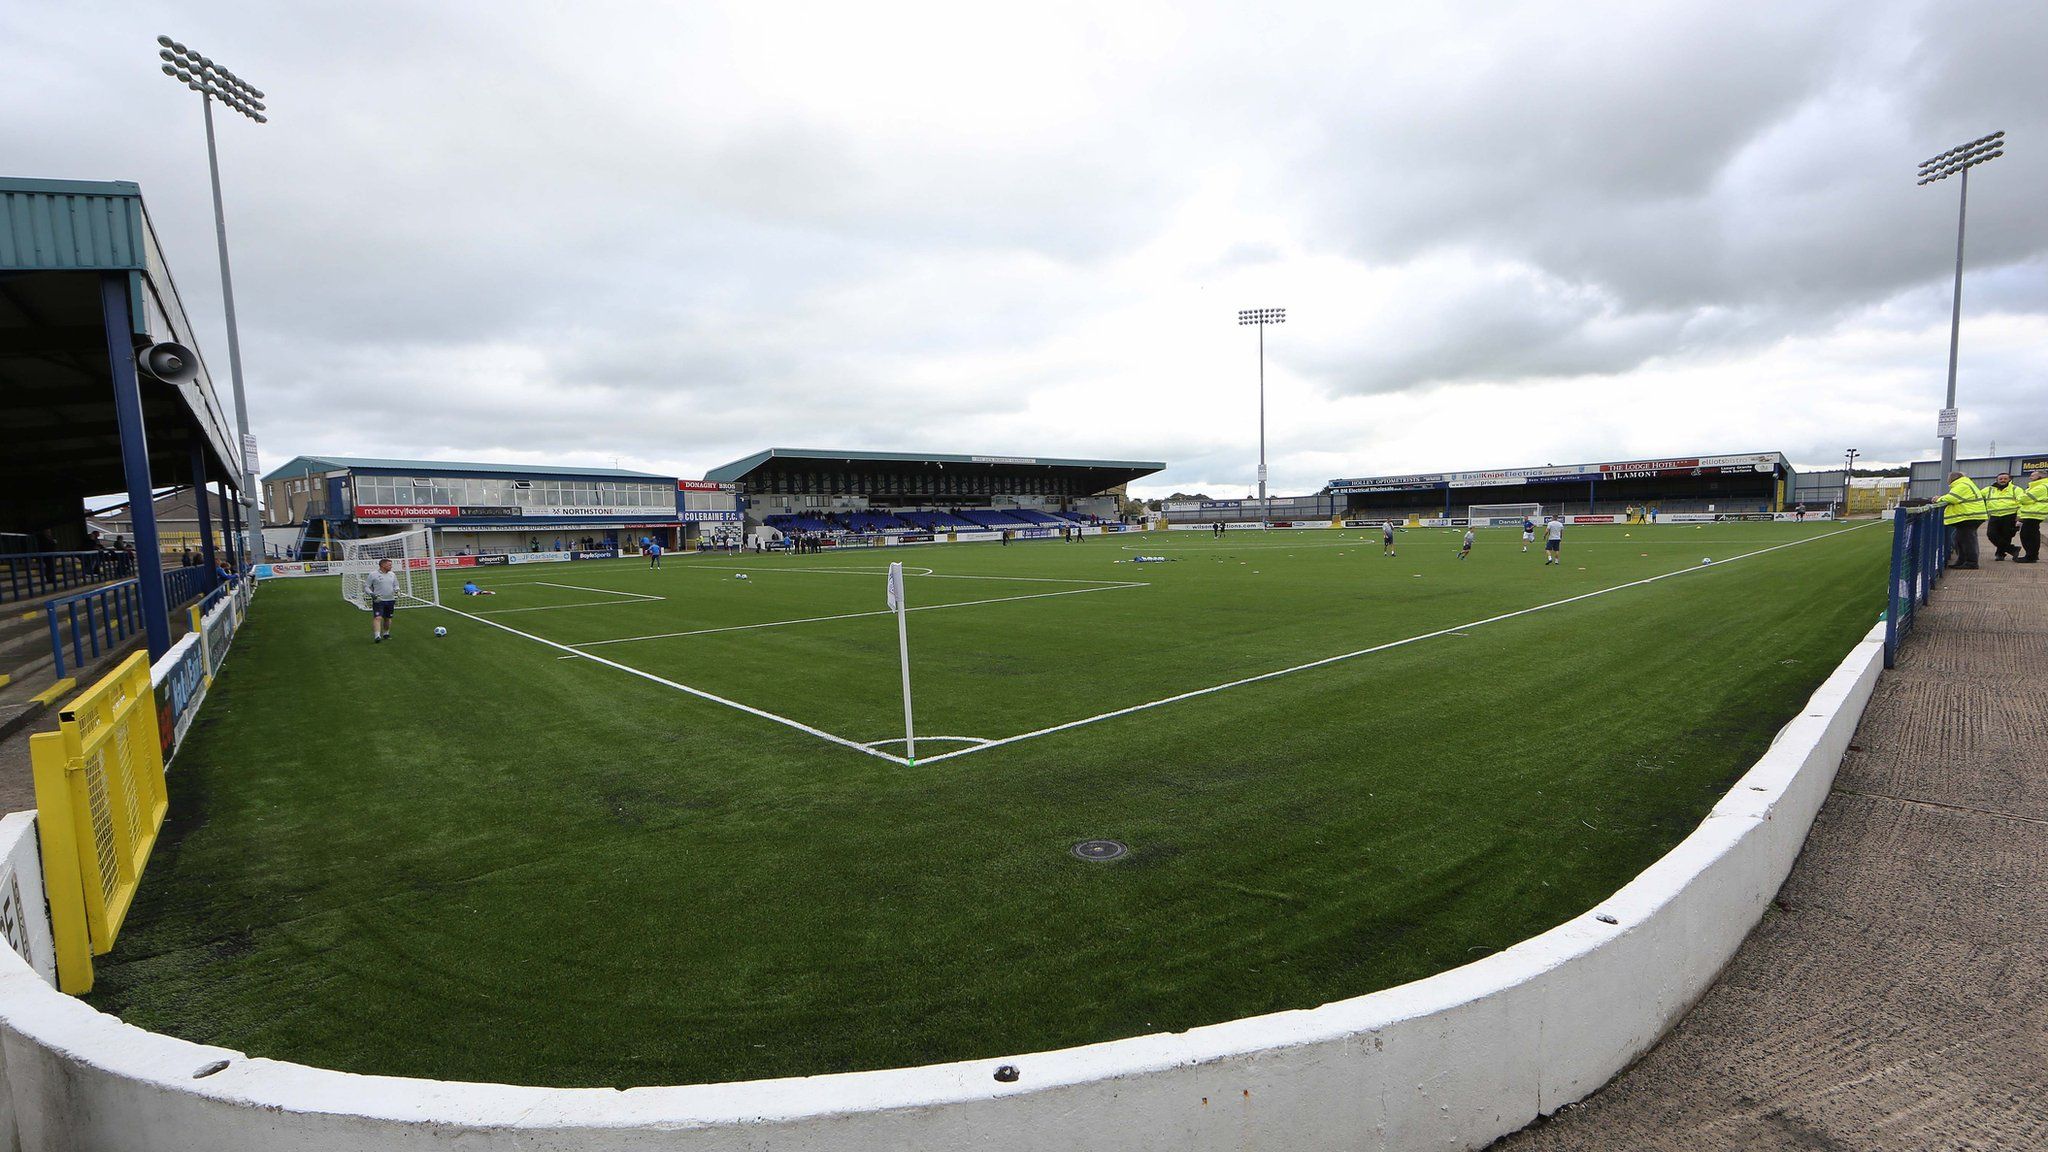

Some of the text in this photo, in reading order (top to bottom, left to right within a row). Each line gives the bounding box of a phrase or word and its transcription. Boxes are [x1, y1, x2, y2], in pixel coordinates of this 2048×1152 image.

[1625, 463, 1649, 471] LODGE
[1651, 461, 1677, 469] HOTEL
[1617, 471, 1658, 479] LAMONT
[685, 481, 736, 490] DONAGHY BROS
[684, 512, 738, 521] COLERAINE F.C.
